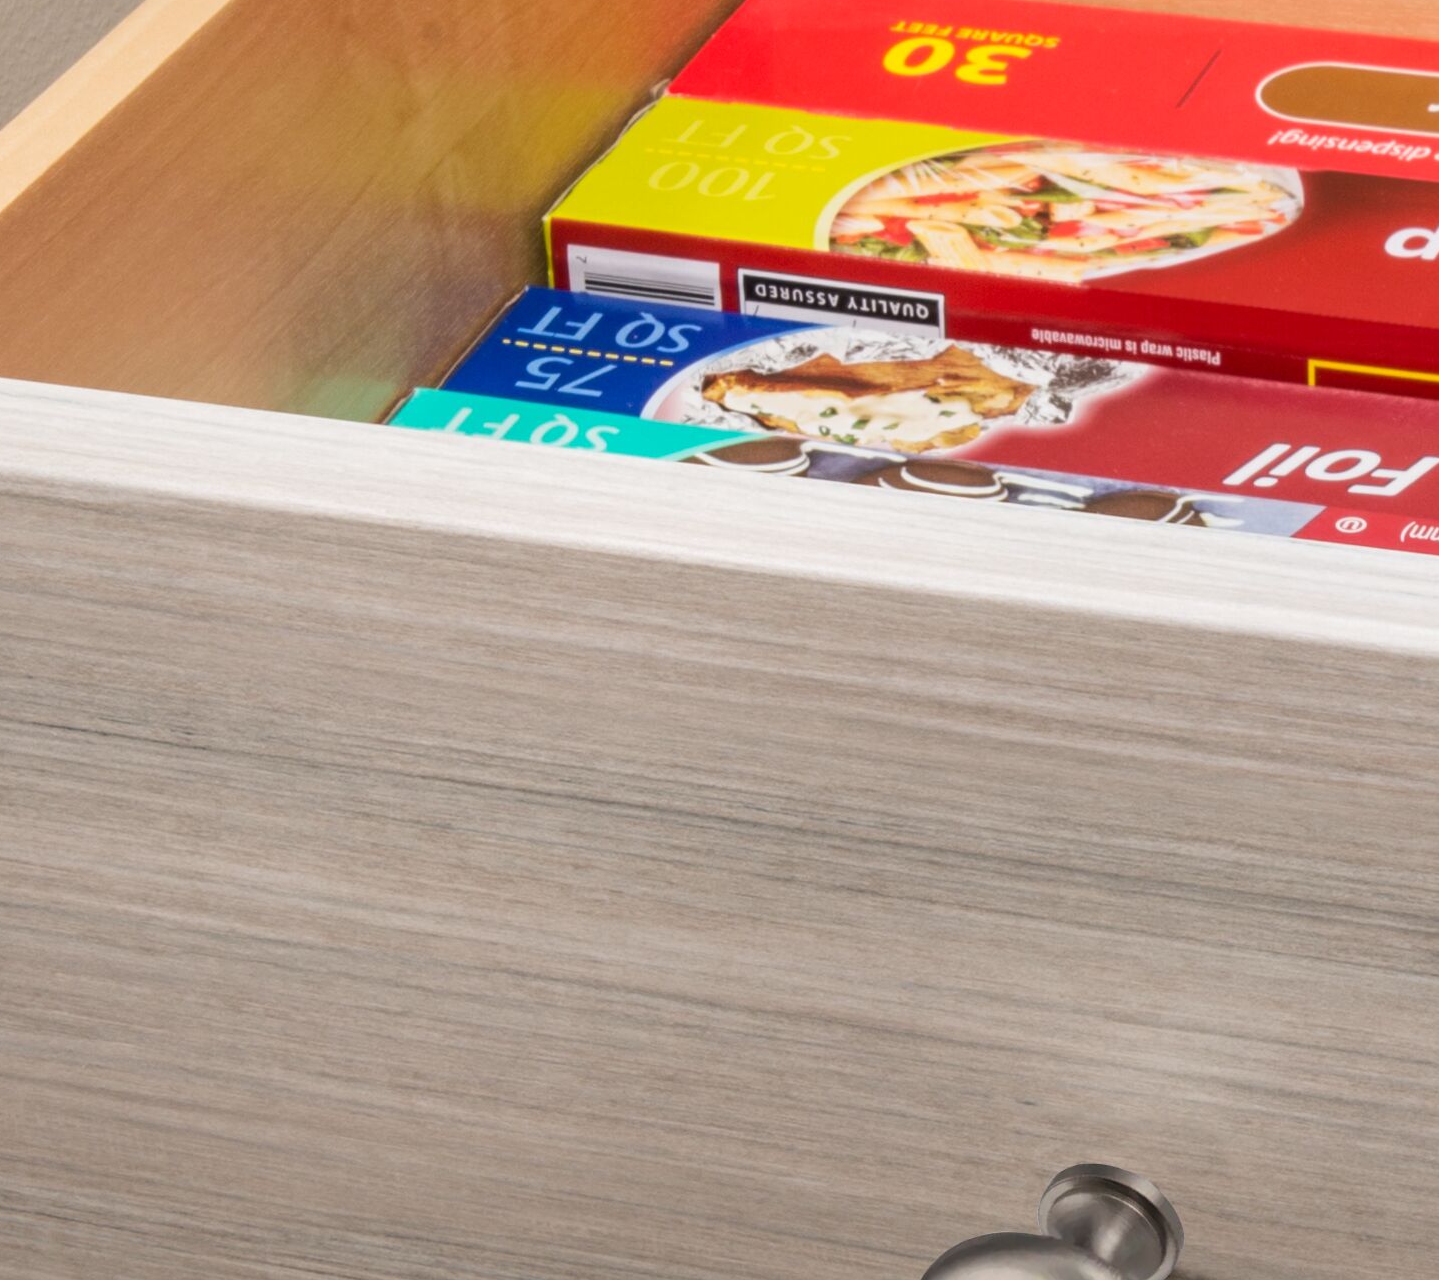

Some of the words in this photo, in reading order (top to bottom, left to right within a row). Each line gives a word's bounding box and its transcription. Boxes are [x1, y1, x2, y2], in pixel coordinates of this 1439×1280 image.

[891, 22, 952, 38] FEET
[959, 28, 1059, 47] SQUARE
[884, 38, 1034, 84] 30
[664, 119, 747, 146] FT
[764, 125, 853, 158] SQ
[647, 161, 776, 201] 100
[755, 283, 838, 307] ASSURED
[847, 296, 928, 319] QUALITY
[516, 306, 601, 336] FT
[615, 313, 703, 354] SQ
[1031, 328, 1121, 351] microwavable
[1124, 339, 1137, 354] is
[1140, 339, 1173, 356] wrap
[1175, 346, 1220, 365] Plastic
[515, 356, 618, 396] 75
[529, 413, 620, 452] SQ
